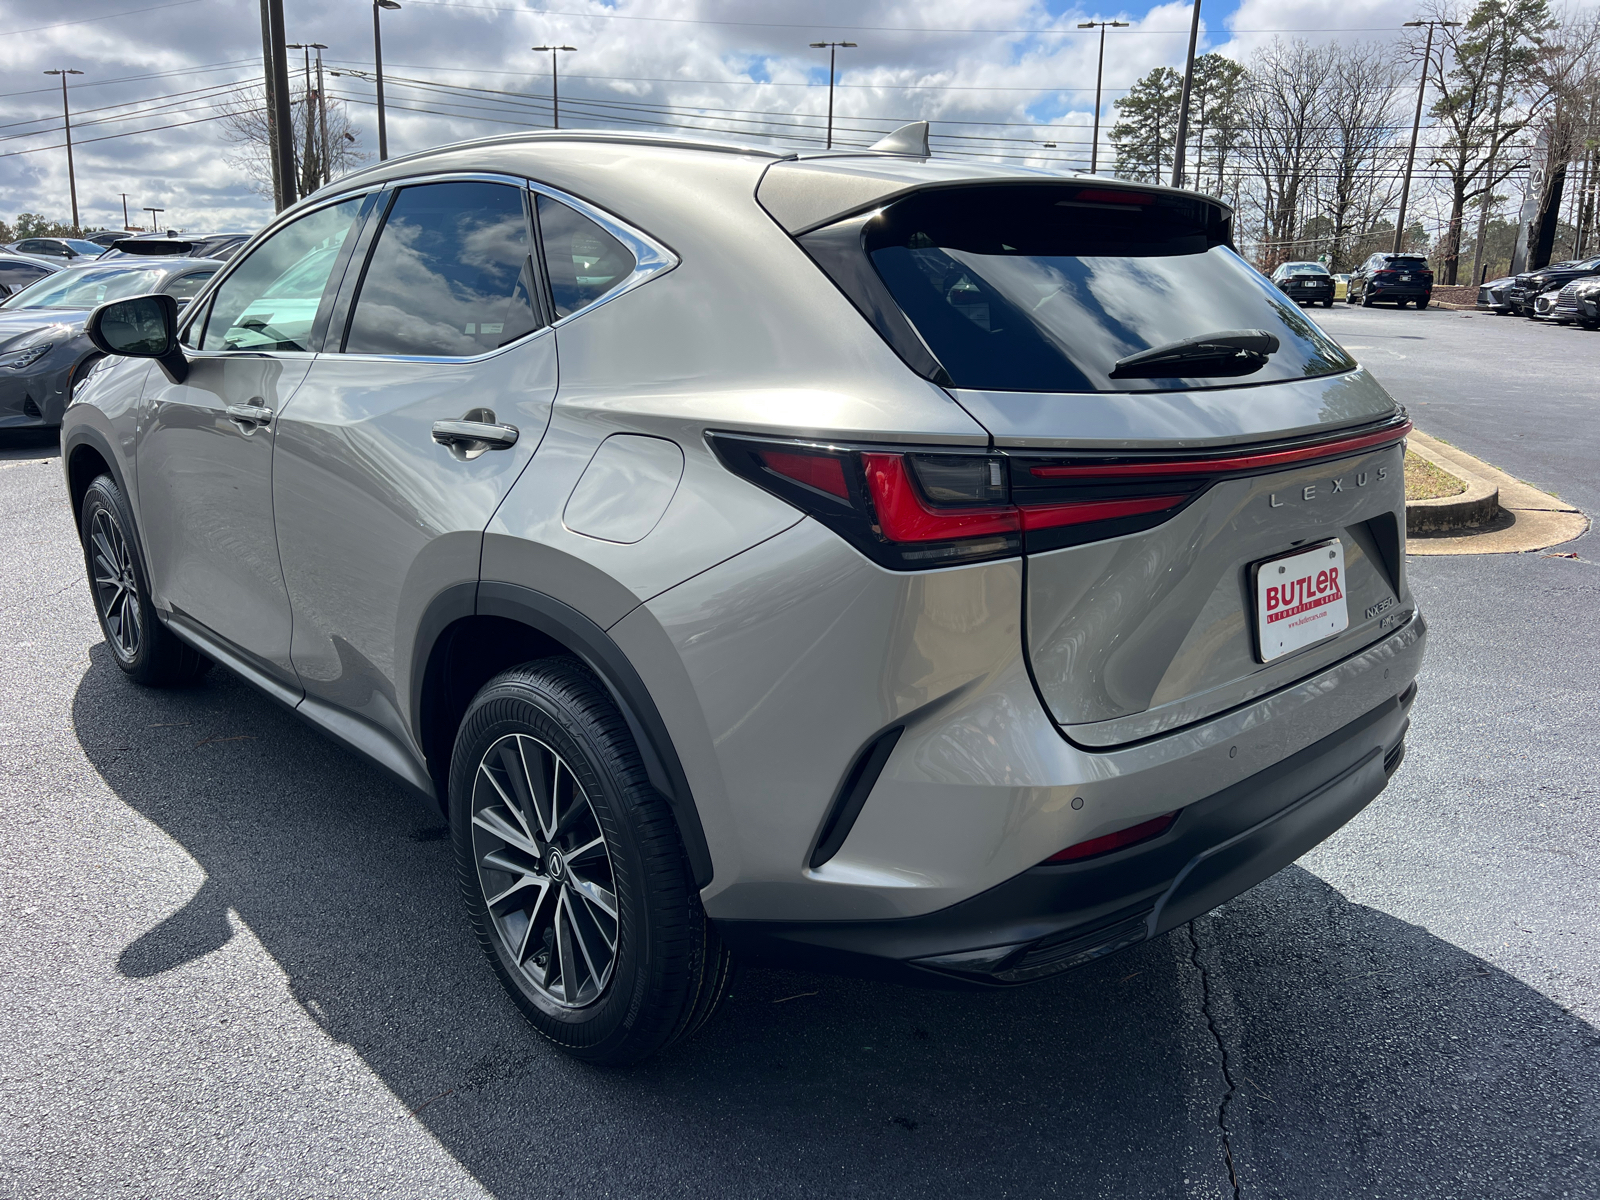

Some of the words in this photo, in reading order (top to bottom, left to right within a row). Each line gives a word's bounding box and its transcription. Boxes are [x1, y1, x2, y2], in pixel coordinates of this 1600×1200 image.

[1270, 467, 1388, 508] LEXUS
[1267, 601, 1315, 623] AUTOMOTIVE
[1320, 592, 1341, 605] GROUP
[1288, 611, 1328, 629] www.butlercars.com
[623, 966, 648, 1031] BRIDGESTONE
